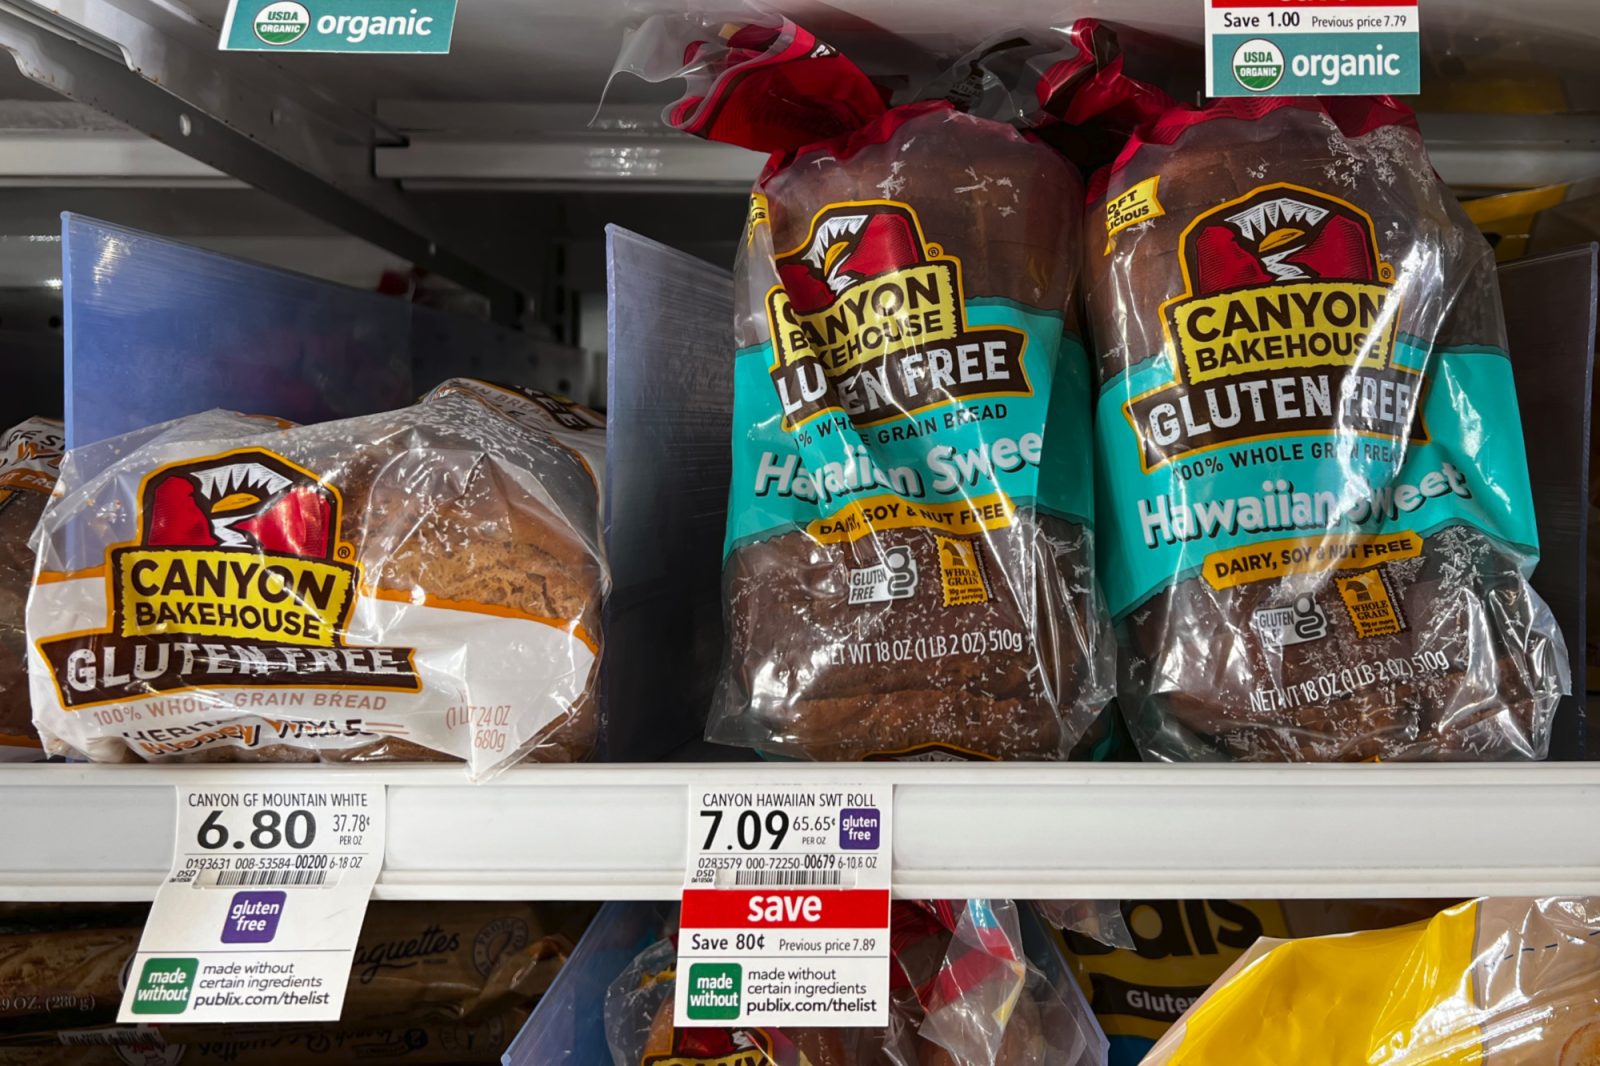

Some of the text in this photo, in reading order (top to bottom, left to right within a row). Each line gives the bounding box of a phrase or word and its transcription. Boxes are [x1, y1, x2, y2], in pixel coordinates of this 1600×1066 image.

[267, 11, 298, 21] USDA
[1224, 11, 1300, 28] Save 1.00
[1311, 15, 1407, 31] Previous price 7.79
[260, 23, 301, 34] ORGANIC
[316, 8, 433, 43] organic
[1243, 51, 1273, 63] USDA
[1292, 43, 1400, 86] organic
[1239, 67, 1277, 78] ORGANIC
[1107, 189, 1137, 216] OFT
[1186, 291, 1387, 343] CANYON
[1198, 332, 1381, 373] BAKEHOUSE
[901, 341, 1010, 397] FREE
[1149, 375, 1333, 447] GLUTEN
[877, 421, 938, 444] GRAIN
[944, 404, 1008, 430] BREAD
[926, 430, 1043, 490] Swee
[1229, 443, 1304, 469] WHOLE
[1311, 441, 1359, 460] GRN
[862, 502, 900, 522] SOY
[906, 505, 917, 518] &
[919, 507, 954, 526] NUT
[960, 502, 1005, 526] FREE
[1137, 479, 1337, 549] Hawaiian
[1215, 550, 1278, 579] DAIRY,
[1281, 545, 1313, 565] SOY
[1328, 541, 1358, 560] NUT
[1364, 538, 1413, 560] FREE
[130, 558, 337, 612] CANYON
[852, 568, 888, 588] GLUTEN
[851, 586, 875, 601] FREE
[1351, 600, 1389, 613] WHOLE
[1357, 608, 1390, 621] GRAIN
[135, 602, 323, 640] BAKEHOUSE
[1260, 610, 1295, 629] GLUTEN
[849, 642, 872, 664] WT
[874, 641, 890, 663] 18
[893, 640, 913, 662] OZ
[915, 638, 927, 663] (1
[929, 636, 947, 659] LB
[949, 635, 959, 655] 2
[961, 632, 987, 656] OZ)
[989, 629, 1022, 653] 510g
[67, 643, 399, 692] GLUTEN FREE
[1249, 690, 1276, 713] NET
[1300, 681, 1319, 703] 18
[1318, 673, 1342, 698] OZ
[1355, 664, 1376, 688] LB
[1376, 661, 1388, 681] 2
[1416, 649, 1449, 674] 510g
[93, 706, 142, 727] 100%
[234, 692, 306, 708] GRAIN
[313, 692, 387, 711] BREAD
[476, 706, 493, 727] 24
[494, 704, 511, 726] OZ
[474, 729, 506, 752] 680g
[188, 793, 368, 807] CANYON GF MOUNTAIN WHITE
[703, 793, 876, 807] CANYON HAWAIIAN SWT ROLL
[197, 809, 370, 850] 6.80 37.78¢
[700, 809, 836, 851] 7.09 65.65¢
[842, 815, 877, 831] gluten
[339, 836, 363, 846] PER OZ
[802, 836, 826, 845] PER OZ
[848, 828, 871, 841] free
[186, 854, 363, 870] 0193631 008-53584-00200 6-18 OZ
[698, 857, 742, 870] 0283579
[746, 854, 836, 870] 000-72250-00679
[865, 856, 878, 869] OZ
[176, 870, 196, 878] DSD
[696, 869, 715, 877] DSD
[231, 900, 280, 920] gluten
[747, 895, 823, 922] save
[236, 916, 267, 932] free
[691, 933, 766, 951] Save 80¢
[779, 938, 876, 955] Previous price 7.89
[149, 967, 187, 984] made
[203, 961, 294, 975] made without
[748, 967, 836, 980] made without
[200, 976, 323, 992] certain ingredients
[697, 973, 733, 990] made
[747, 981, 867, 998] certain ingredients
[138, 986, 189, 1001] without
[194, 991, 330, 1010] publix.com/thelist
[690, 990, 739, 1008] without
[746, 998, 877, 1016] publix.com/thelist
